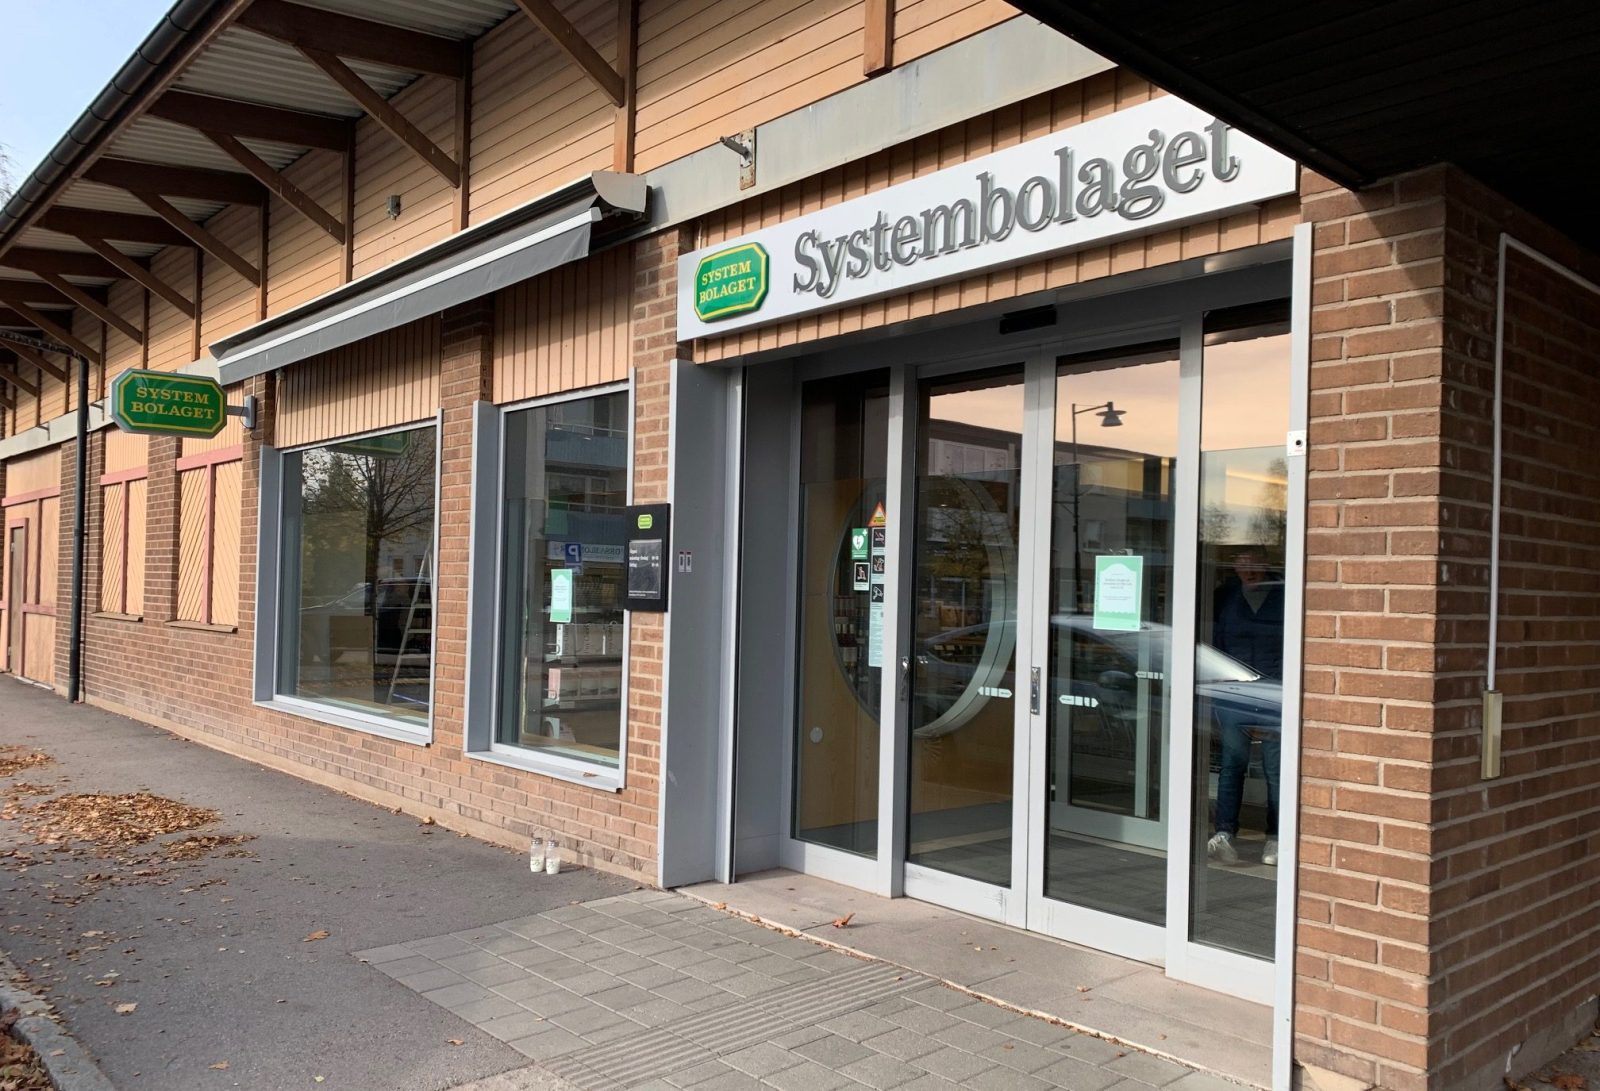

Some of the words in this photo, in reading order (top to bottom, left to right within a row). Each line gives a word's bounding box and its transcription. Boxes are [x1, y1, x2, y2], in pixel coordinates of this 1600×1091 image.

[793, 117, 1240, 298] Systembolaget
[701, 260, 752, 286] SYSTEM
[699, 276, 757, 304] BOLAGET
[136, 386, 210, 404] SYSTEM
[130, 401, 215, 419] BOLAGET
